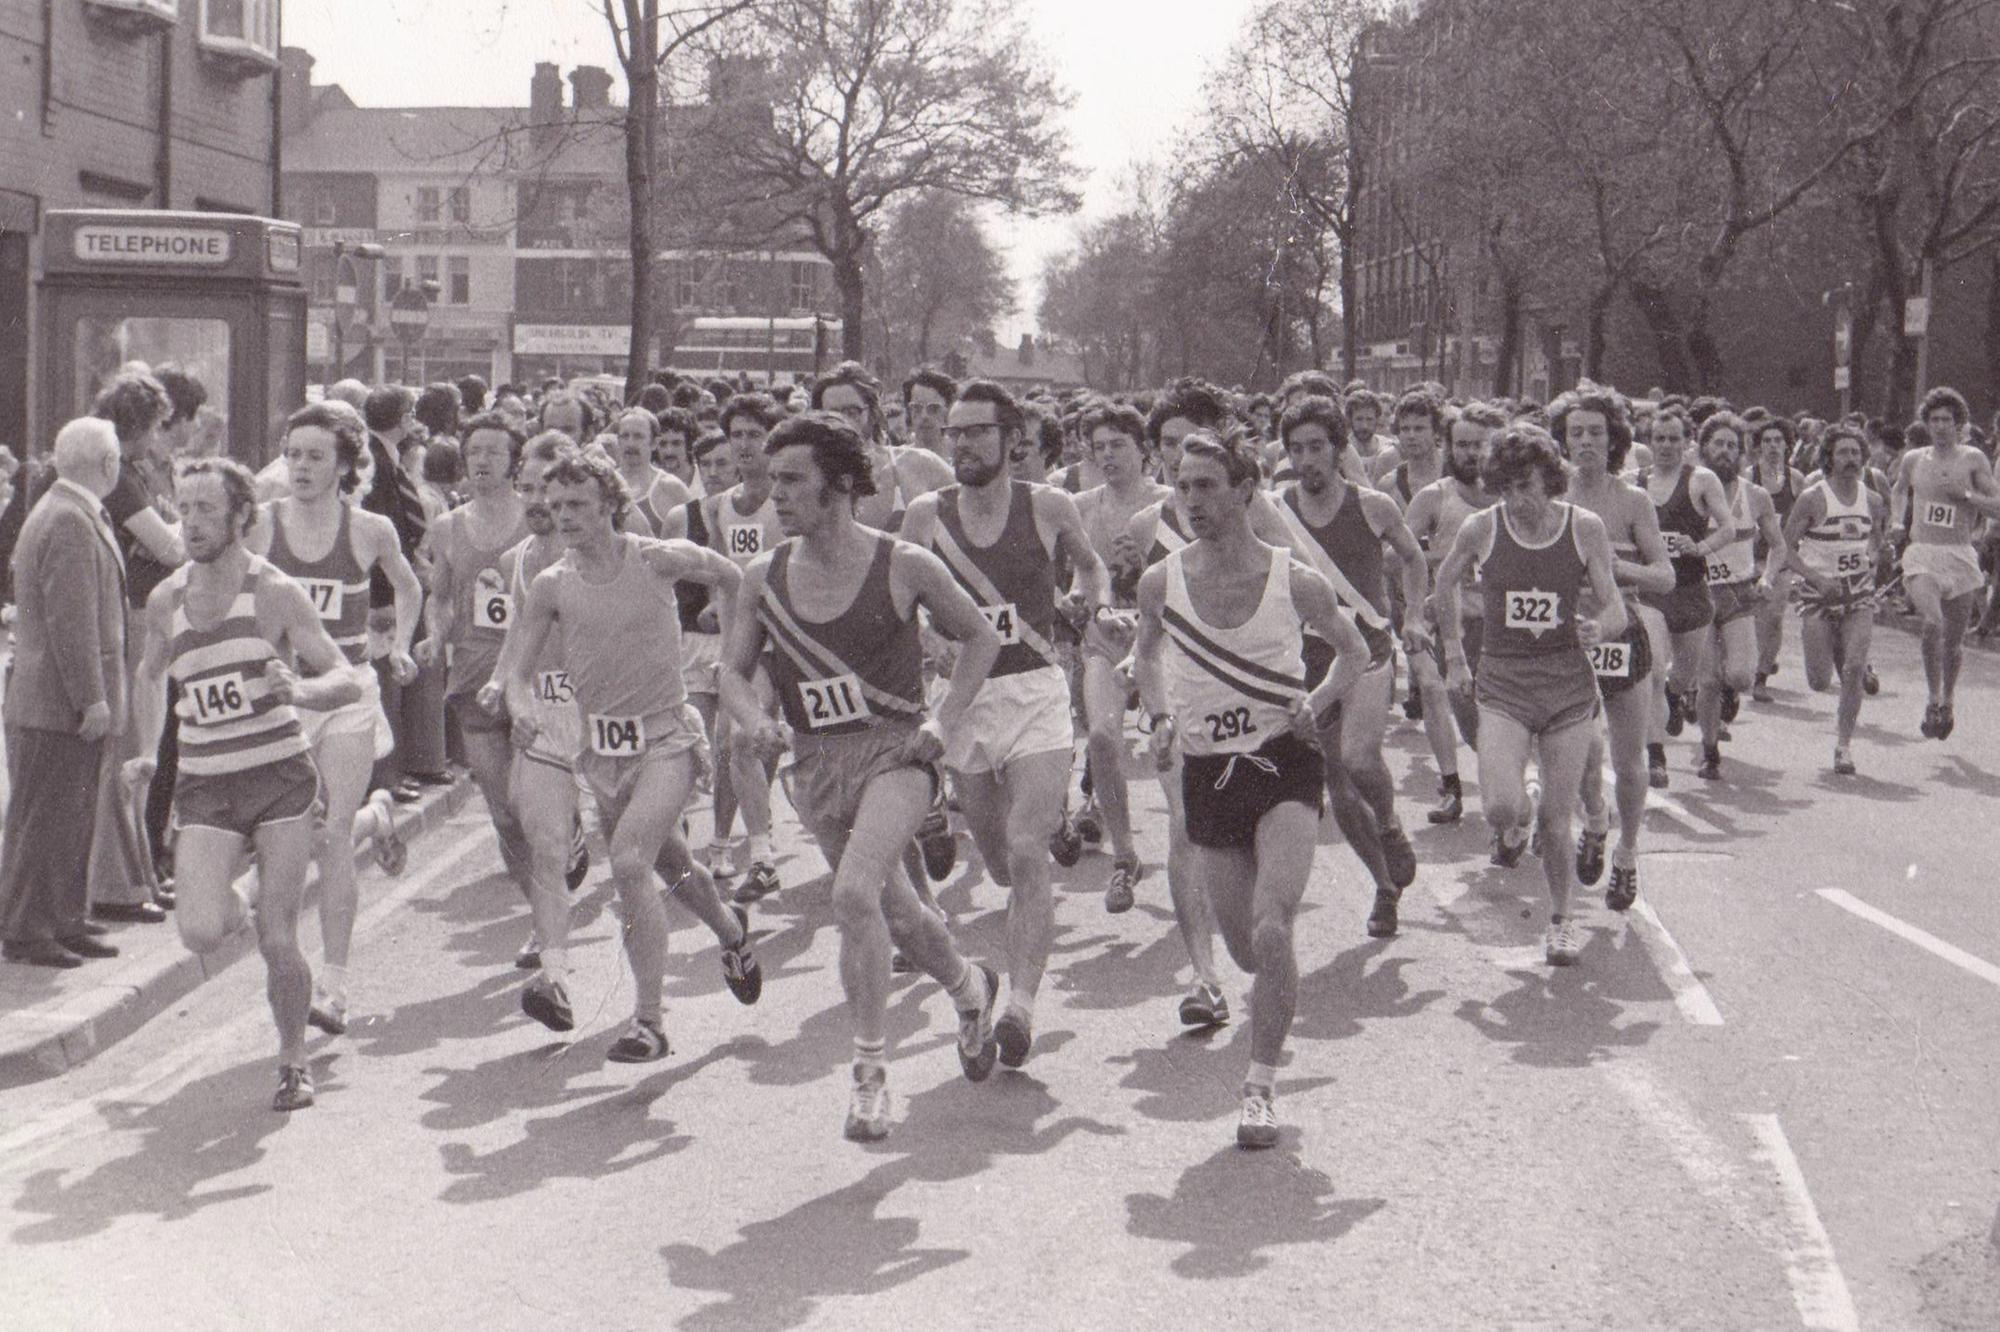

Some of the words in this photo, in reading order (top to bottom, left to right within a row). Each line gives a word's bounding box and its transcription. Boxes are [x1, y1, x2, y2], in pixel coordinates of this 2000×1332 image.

[84, 233, 220, 255] TELEPHONE
[1927, 504, 1952, 525] 191
[731, 528, 759, 553] 198
[1837, 553, 1860, 572] 55
[487, 597, 507, 624] 6
[1511, 597, 1552, 622] 322
[984, 610, 1012, 639] 4
[1591, 647, 1623, 671] 218
[194, 681, 242, 718] 146
[543, 672, 574, 704] 43
[806, 682, 856, 720] 211
[597, 719, 639, 751] 104
[1204, 707, 1257, 743] 292
